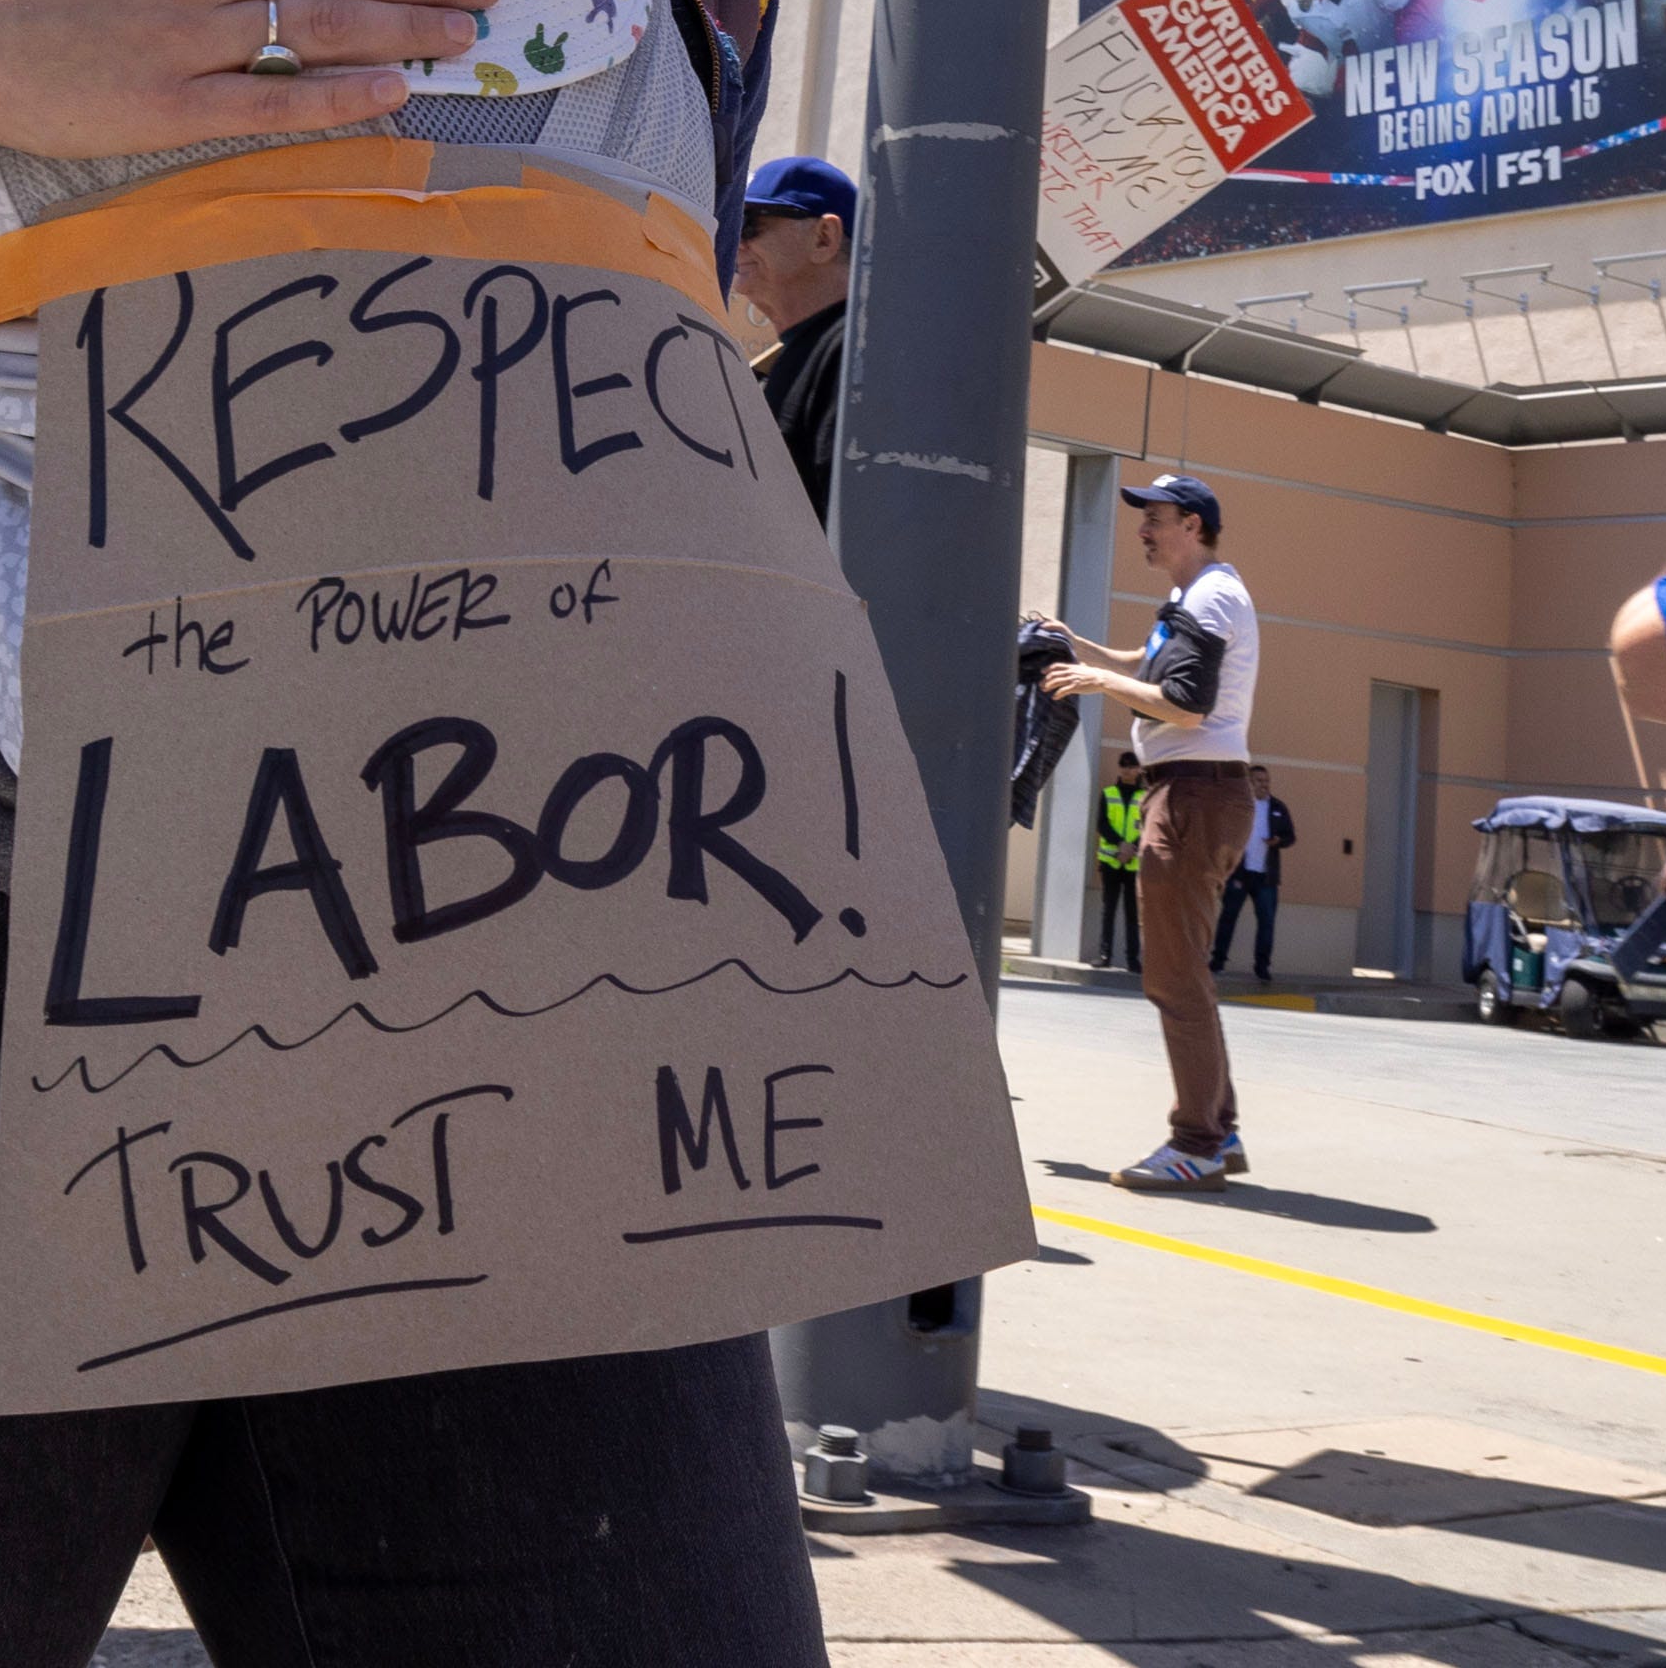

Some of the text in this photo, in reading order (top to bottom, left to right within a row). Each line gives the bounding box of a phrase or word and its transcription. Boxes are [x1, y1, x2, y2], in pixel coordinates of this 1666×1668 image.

[1054, 84, 1126, 143] PAY
[1137, 5, 1245, 154] AMERICA
[1231, 92, 1261, 124] OF
[1345, 38, 1440, 117] NEW
[1378, 76, 1601, 154] BEGINS APRIL 15
[1415, 145, 1563, 200] FOX FS1
[1062, 202, 1124, 253] THAT
[76, 255, 759, 561] RESPECT
[122, 558, 620, 674] the POWER of
[44, 670, 867, 1026] LABOR!
[64, 1063, 836, 1285] TRUST ME
